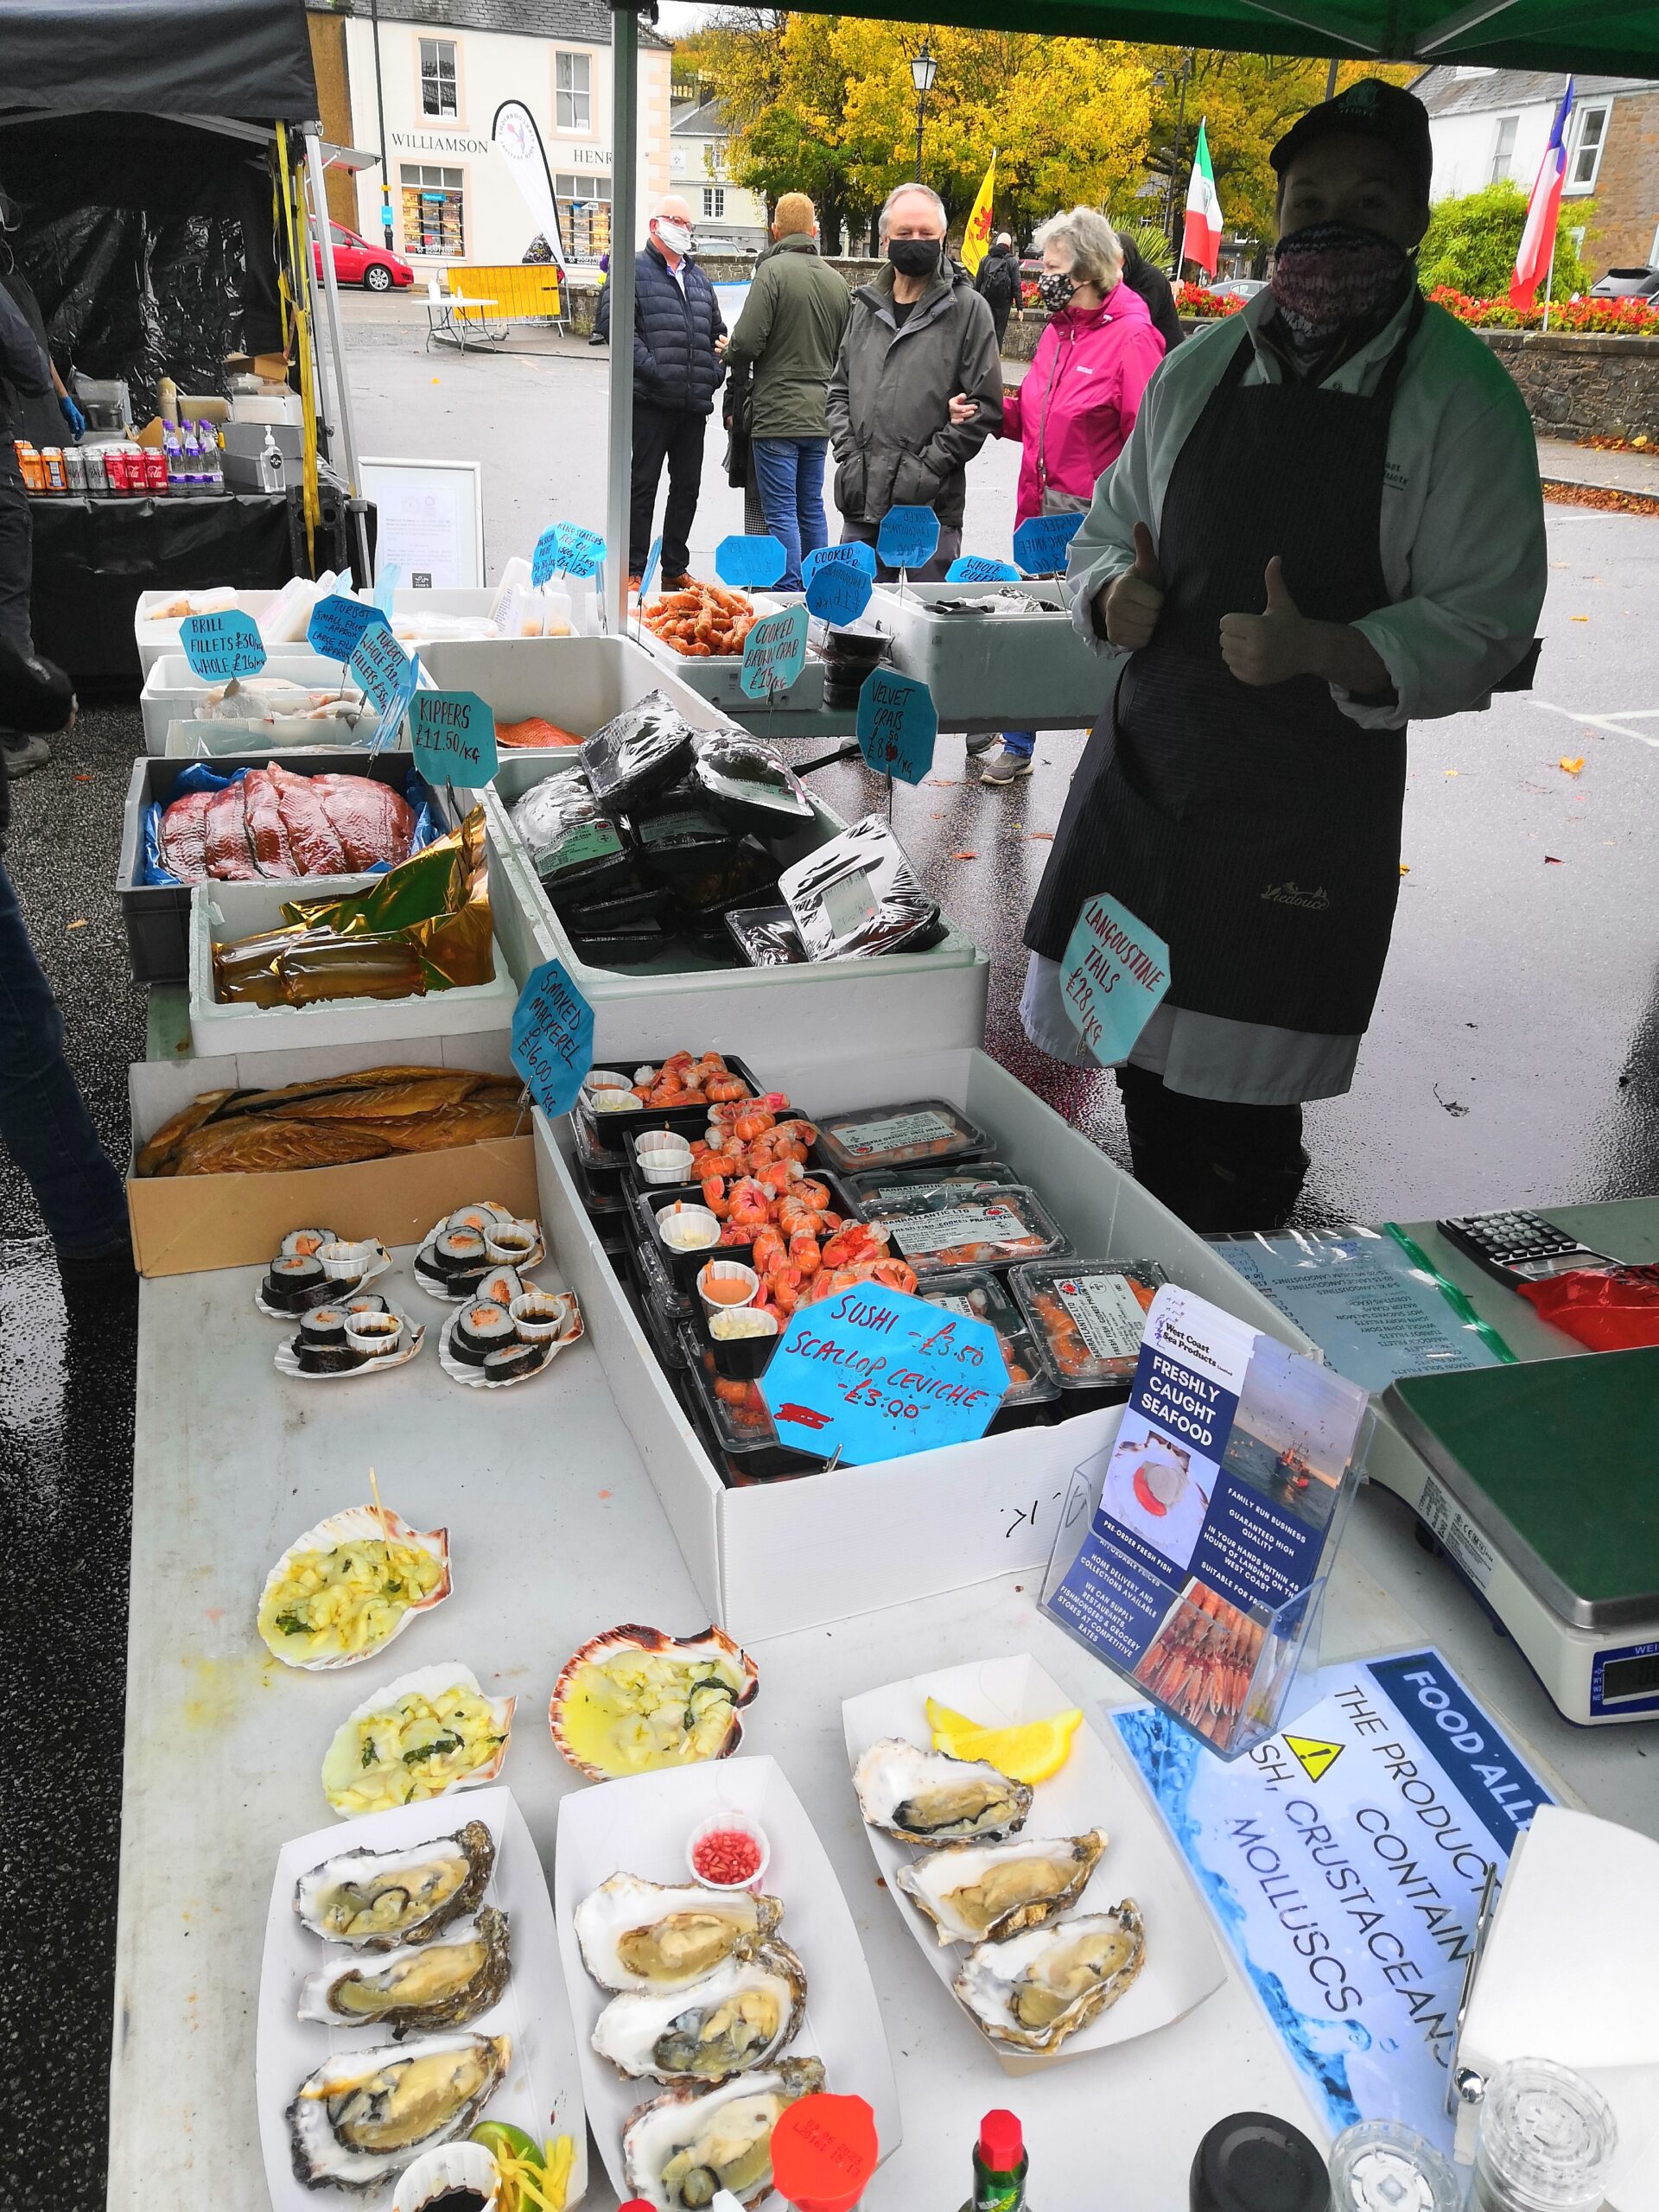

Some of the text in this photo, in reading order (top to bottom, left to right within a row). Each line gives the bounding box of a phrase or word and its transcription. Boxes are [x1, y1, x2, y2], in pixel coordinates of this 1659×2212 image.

[391, 133, 488, 155] WILLIAMSON
[574, 149, 613, 164] HENR
[557, 523, 575, 534] KING
[815, 547, 854, 563] COOKED
[966, 558, 1001, 574] WHOLE
[192, 618, 224, 632] BRILL
[315, 610, 343, 626] SMALL
[332, 601, 376, 619] TURBOT
[191, 638, 233, 652] FILLETS
[312, 631, 336, 645] LARGE
[376, 628, 406, 667] TURBOT
[755, 616, 794, 645] COOKED
[193, 658, 230, 674] WHOLE
[352, 649, 378, 684] FILLETS
[360, 634, 385, 668] WHOLE
[744, 639, 799, 669] BROWN CRAB
[872, 678, 916, 706] VELVET
[420, 698, 472, 728] KIPPERS
[874, 708, 903, 729] CRAB
[1085, 901, 1165, 992] LANGOUSTINE
[1084, 944, 1120, 993] TAILS
[541, 970, 582, 1030] SMOKED
[529, 997, 582, 1070] MACKEREL
[1272, 1274, 1331, 1285] LANGOUSTINES
[831, 1295, 899, 1334] SUSHI
[1068, 1302, 1102, 1358] BARRATLANTIC LTD
[1101, 1325, 1113, 1338] FISH
[1108, 1338, 1122, 1356] FRESH
[1163, 1332, 1177, 1346] Sea
[1178, 1339, 1217, 1367] Products
[1165, 1323, 1210, 1354] West Coast
[785, 1331, 988, 1408] SCALLOP CEVICHE
[1153, 1355, 1220, 1403] FRESHLY
[1149, 1376, 1217, 1424] CAUGHT
[1141, 1393, 1212, 1446] SEAFOOD
[1228, 1488, 1306, 1543] FAMILY RUN BUSINESS
[1229, 1510, 1294, 1556] GUARANTEED HIGH
[1103, 1520, 1172, 1573] PRE-ORDER FRESH FISH
[1208, 1525, 1299, 1592] IN YOUR HANDS WITHIN 48
[1242, 1529, 1274, 1552] QUALITY
[1091, 1554, 1154, 1604] HOME DELIVERY AND
[1201, 1561, 1248, 1600] SUITABLE FOR
[1204, 1532, 1296, 1599] HOURS OF LANDING ON TH
[1224, 1557, 1270, 1592] WEST COAST
[1080, 1556, 1157, 1618] COLLECTIONS AVAILABLE
[1085, 1581, 1134, 1622] WE CAN SUPPLY
[1058, 1596, 1133, 1657] STORES AT COMPETITIVE
[1060, 1586, 1103, 1622] FISHMONGERS
[1110, 1625, 1141, 1651] GROCERY
[1078, 1624, 1098, 1642] RATES
[1635, 1644, 1659, 1654] WEI
[1334, 1684, 1389, 1737] THE
[1402, 1670, 1484, 1755] FOOD
[1249, 1740, 1295, 1791] SH,
[1357, 1808, 1469, 1963] CONTAIN
[1226, 1817, 1363, 2013] MOLLUSCS
